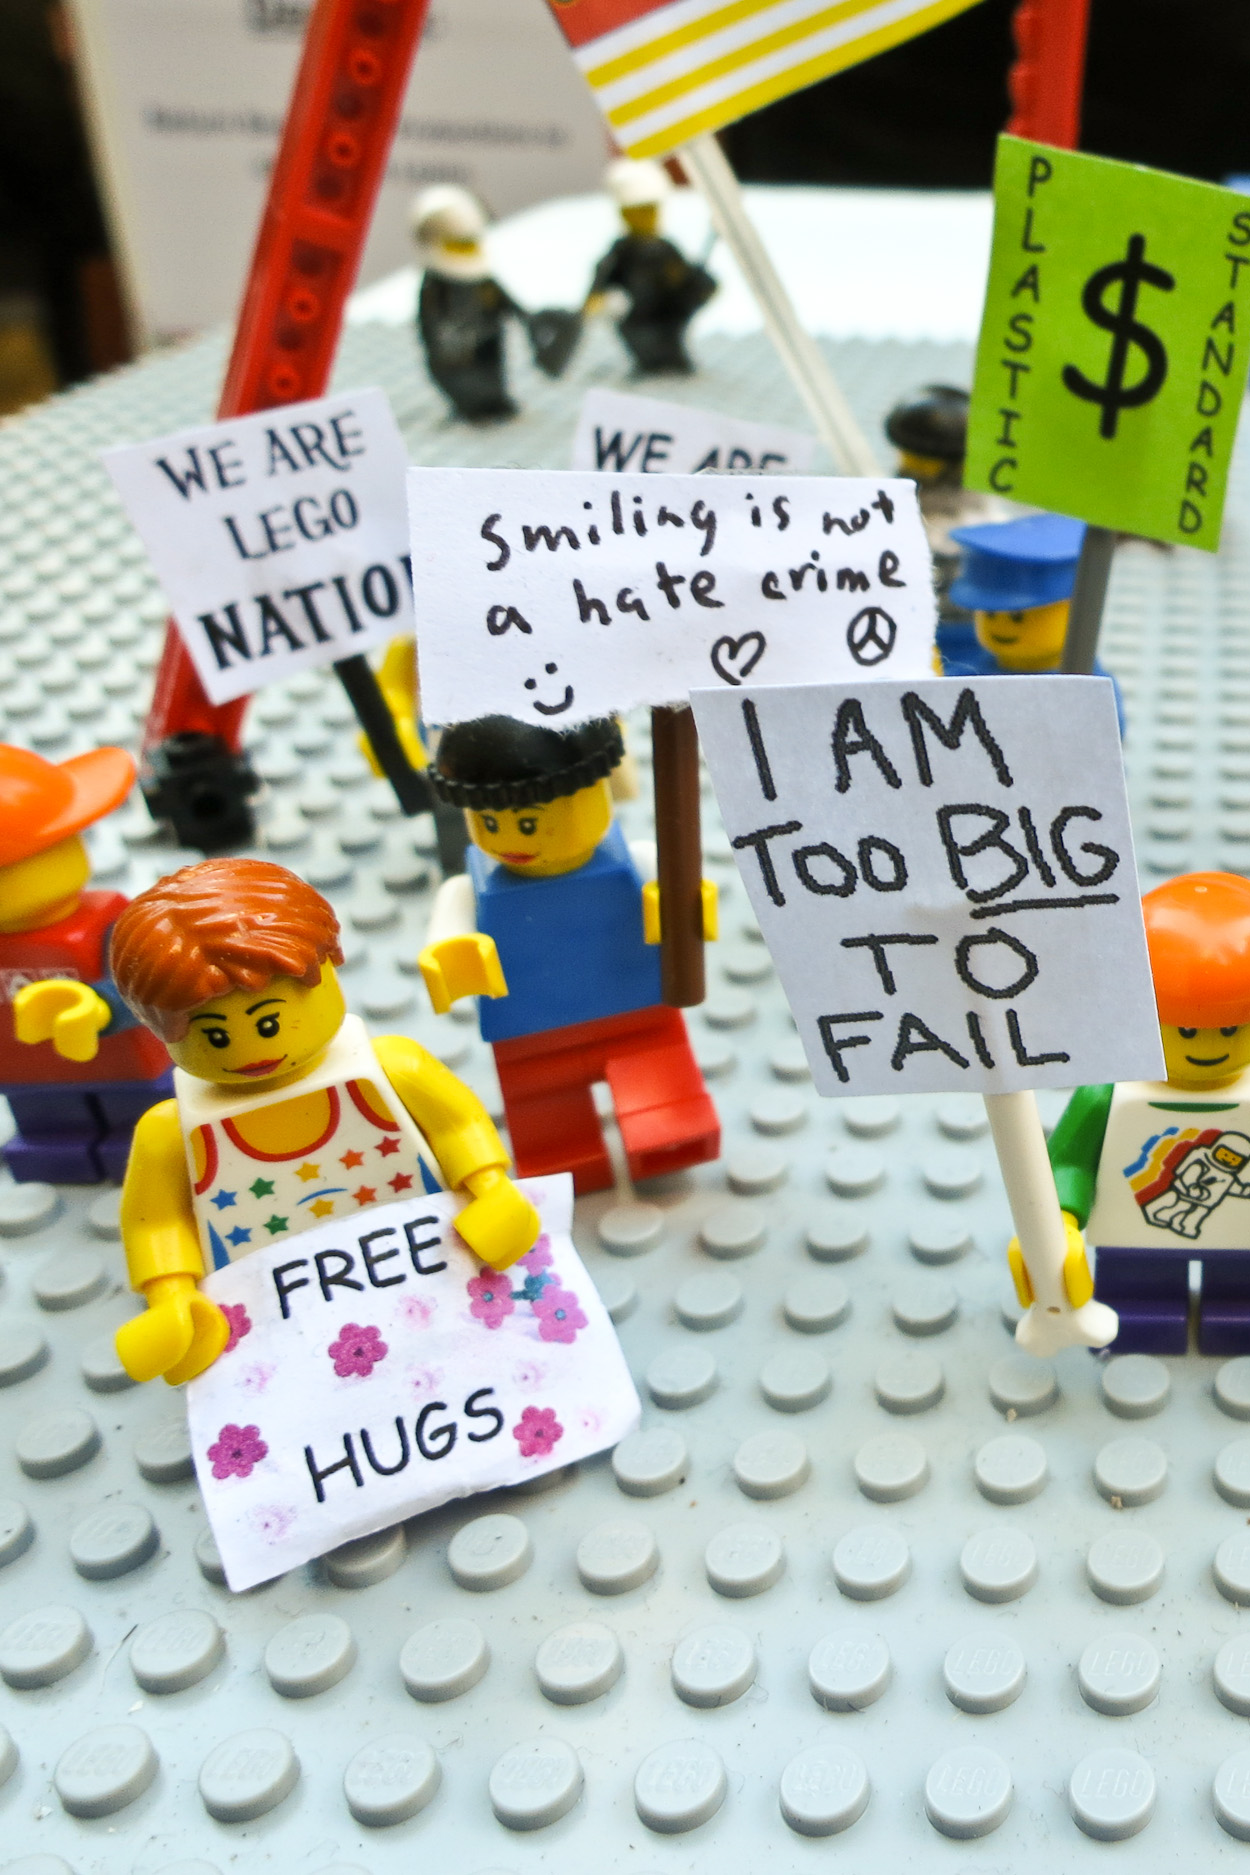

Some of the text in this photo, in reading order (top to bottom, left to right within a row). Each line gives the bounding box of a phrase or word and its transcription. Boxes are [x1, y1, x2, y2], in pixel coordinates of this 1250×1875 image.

[988, 156, 1053, 493] PLASTIC
[154, 410, 366, 501] WE ARE
[593, 425, 673, 473] WE
[223, 489, 359, 560] LEGO
[746, 493, 790, 531] is
[822, 489, 896, 536] not
[486, 549, 907, 636] a hate crime
[741, 688, 1014, 801] I AM
[937, 803, 1120, 904] BIG
[841, 927, 1039, 999] TO
[817, 1008, 1070, 1083] FAIL
[272, 1215, 448, 1320] FREE
[304, 1387, 505, 1503] HUGS
